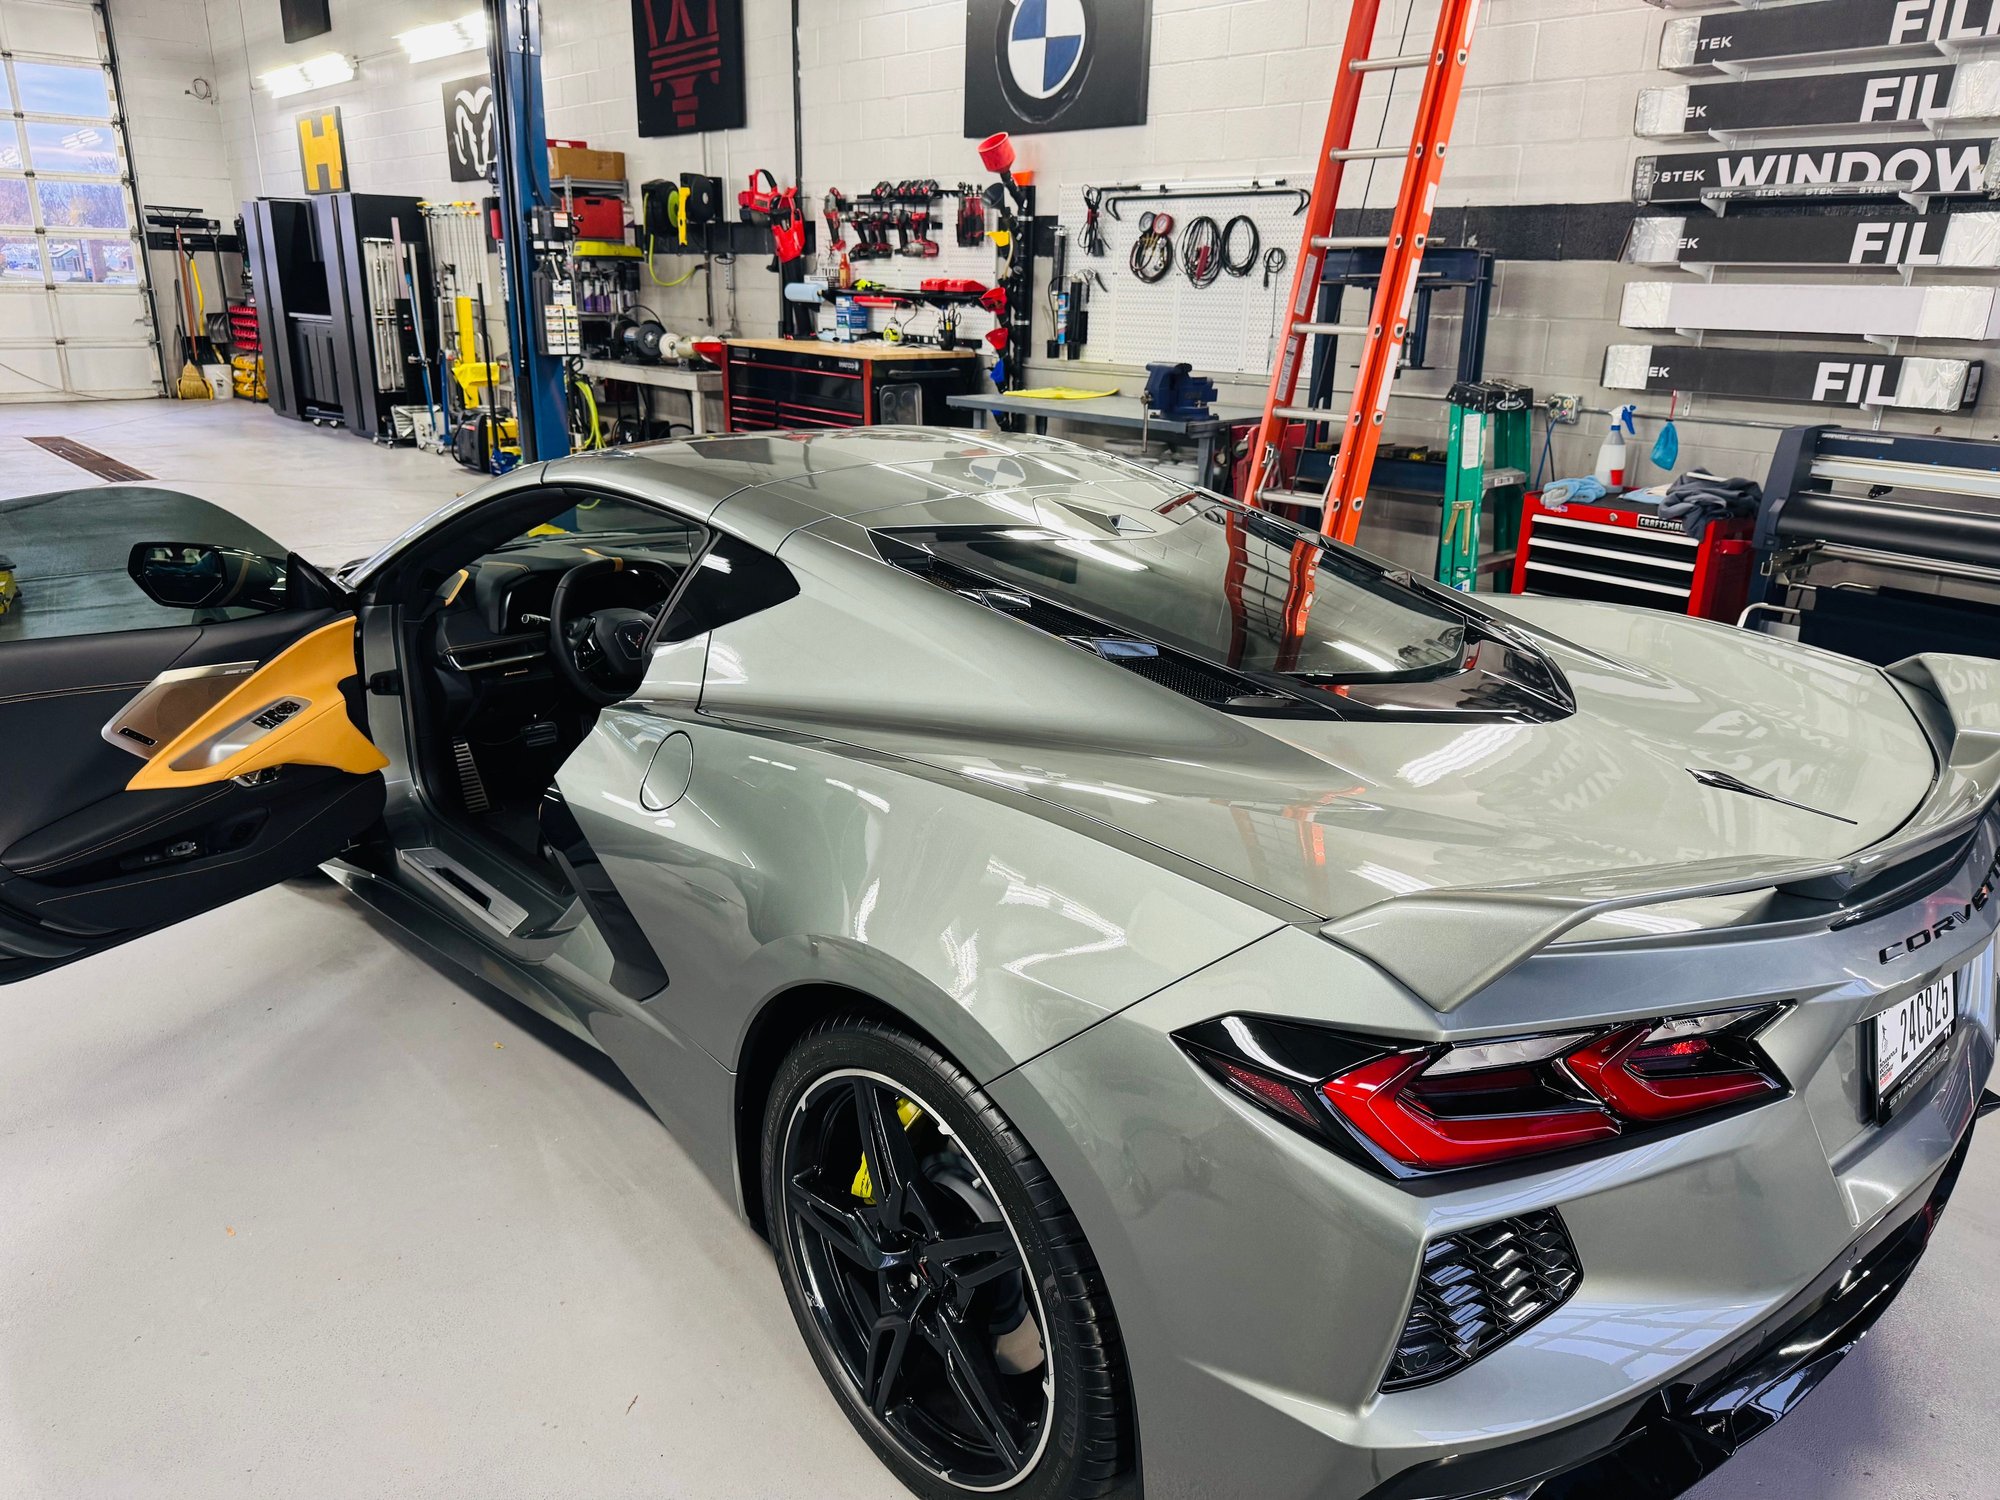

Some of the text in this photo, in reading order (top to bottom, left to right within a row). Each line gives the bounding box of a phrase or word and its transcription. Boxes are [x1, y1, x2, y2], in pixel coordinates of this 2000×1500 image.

[1859, 73, 1951, 122] FIL
[1685, 105, 1708, 119] EK
[1660, 146, 1985, 192] STEK WINDOW
[1706, 186, 1888, 199] STEK STEK STEK STEK
[1678, 222, 1940, 265] EK FIL
[1648, 366, 1670, 378] EK
